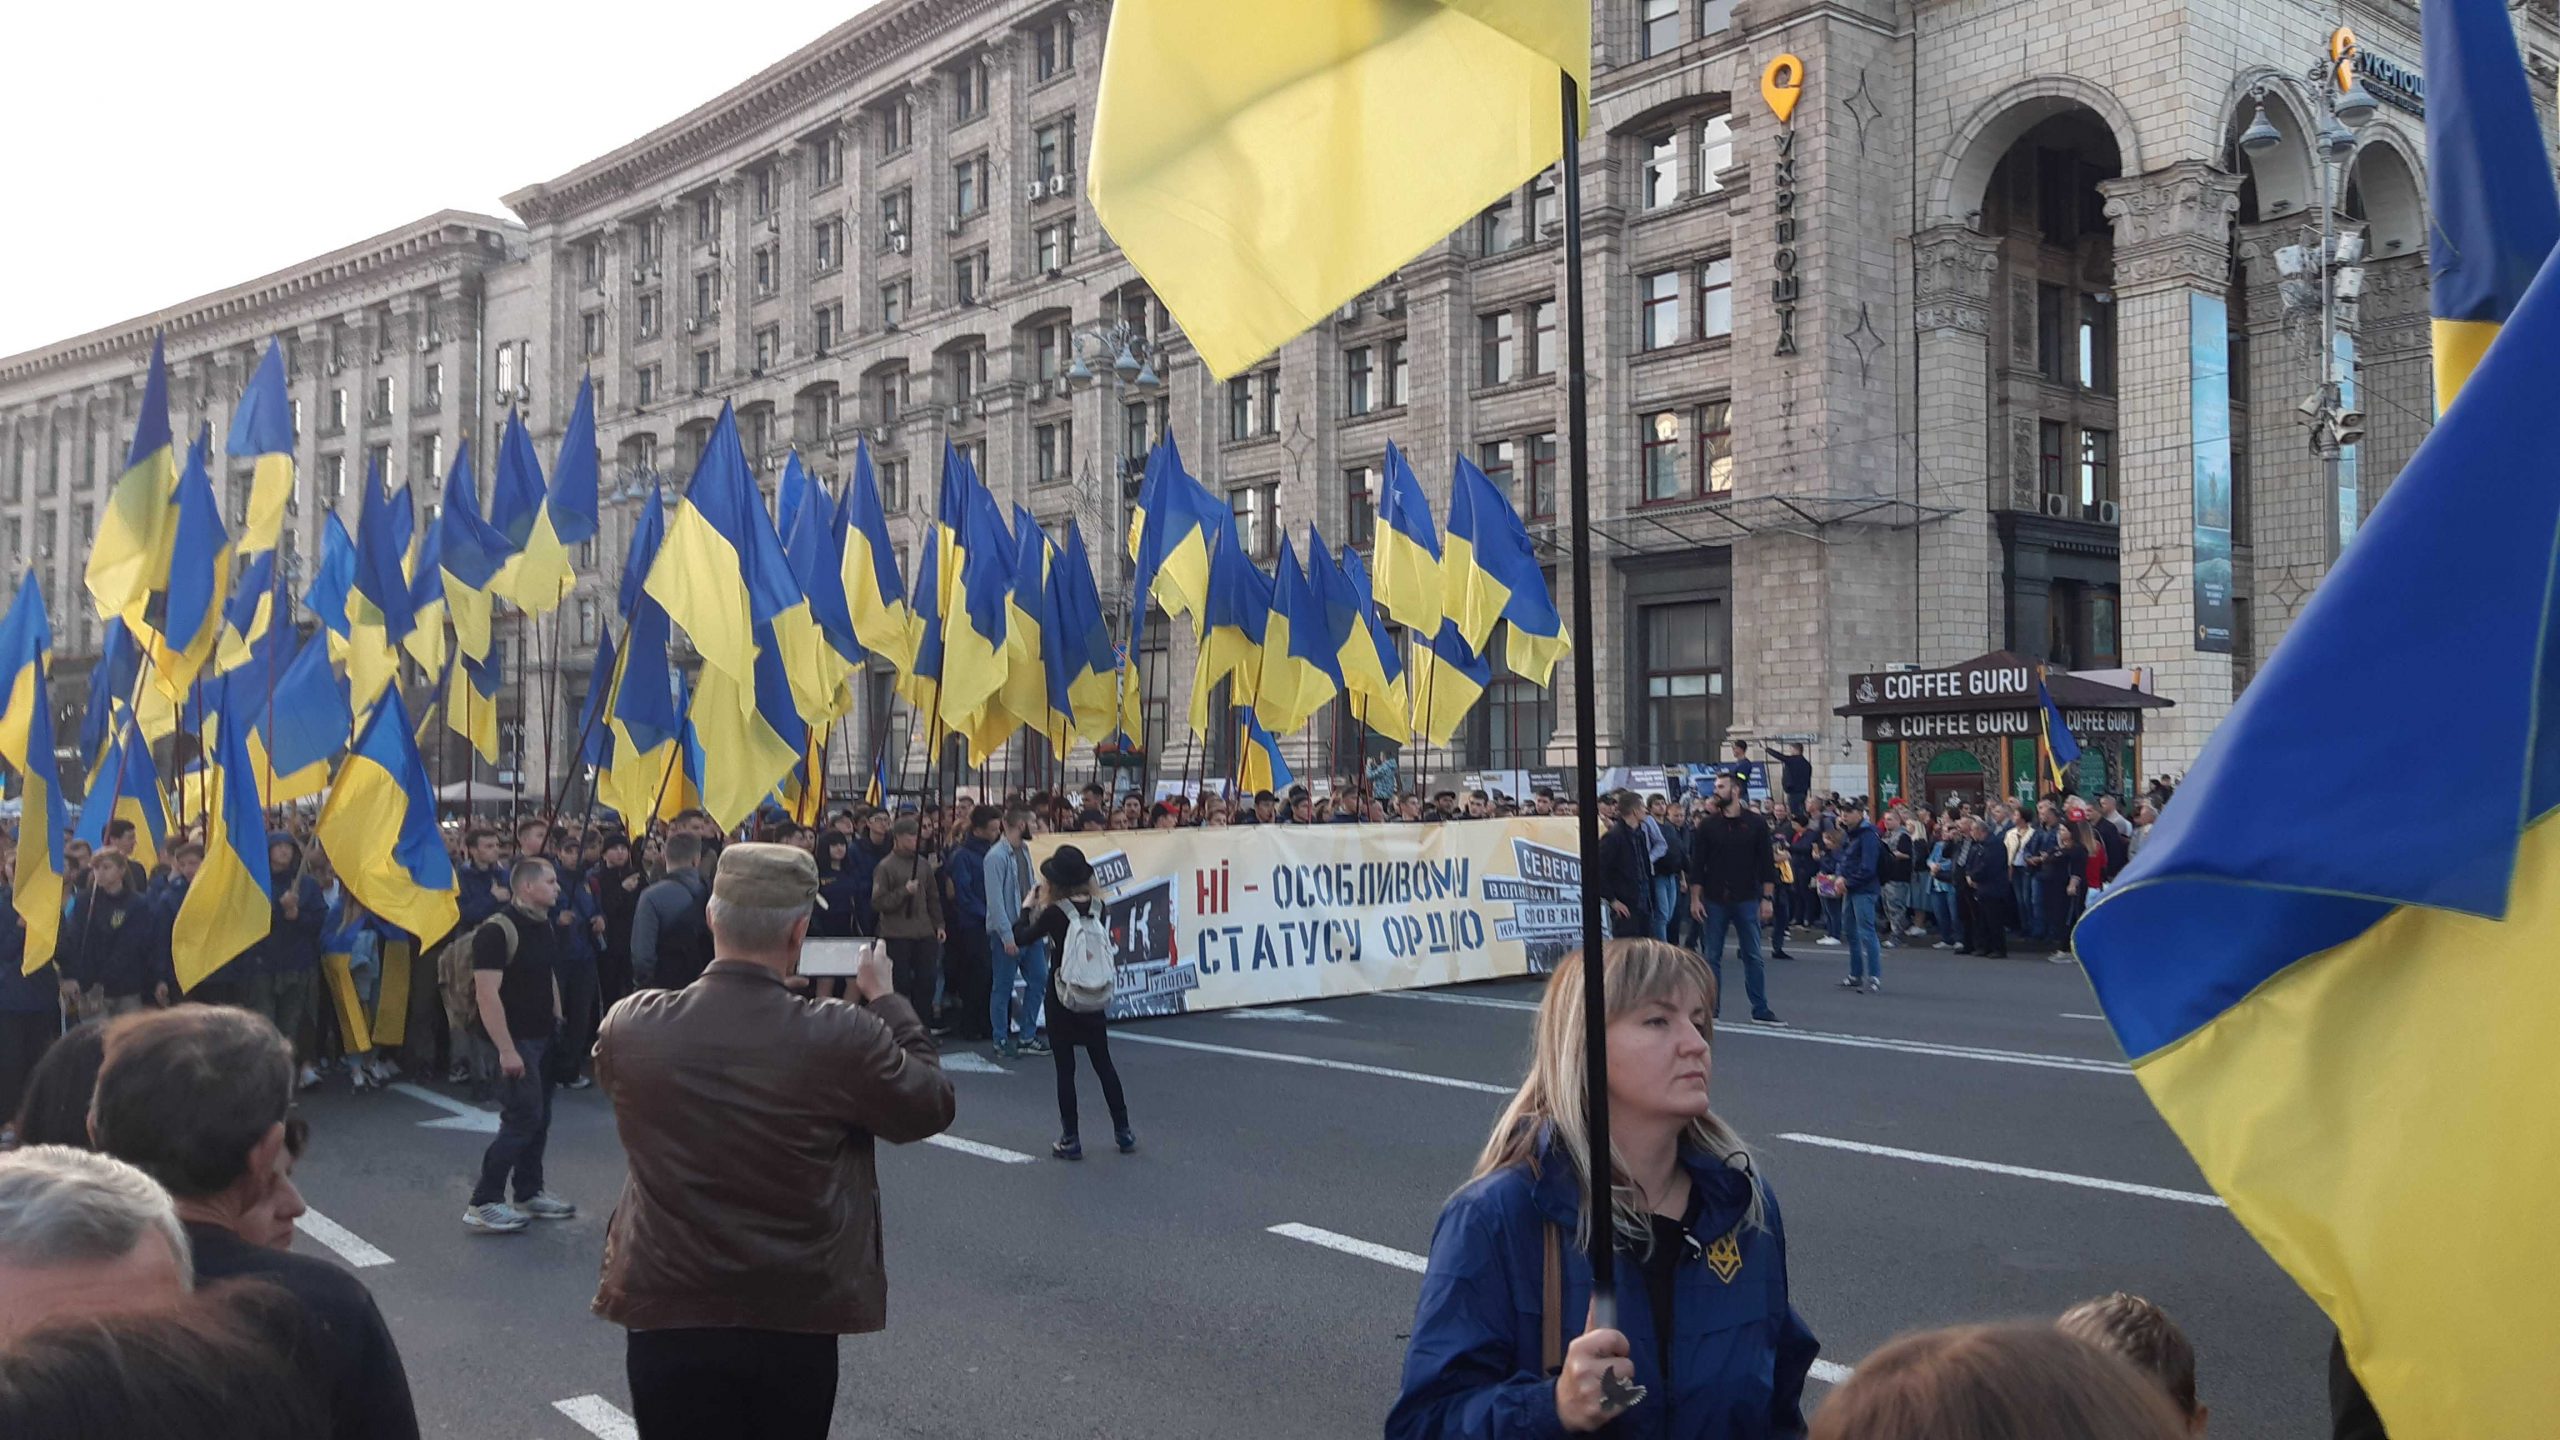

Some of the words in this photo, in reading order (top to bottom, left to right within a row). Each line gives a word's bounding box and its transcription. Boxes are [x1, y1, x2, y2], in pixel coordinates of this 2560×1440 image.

[1772, 131, 1798, 356] УКРПОШТА
[1884, 671, 1961, 700] COFFEE
[1968, 667, 2028, 694] GURU
[1900, 713, 1970, 737] COFFEE
[1976, 711, 2029, 734] GURU
[2066, 710, 2105, 732] COFFEE
[1522, 848, 1581, 881] СЕВЕРО
[1272, 857, 1470, 910] ОСОБЛИВОМУ
[1199, 918, 1362, 975] СТАТУСУ
[1383, 909, 1485, 958] ОРДЛО
